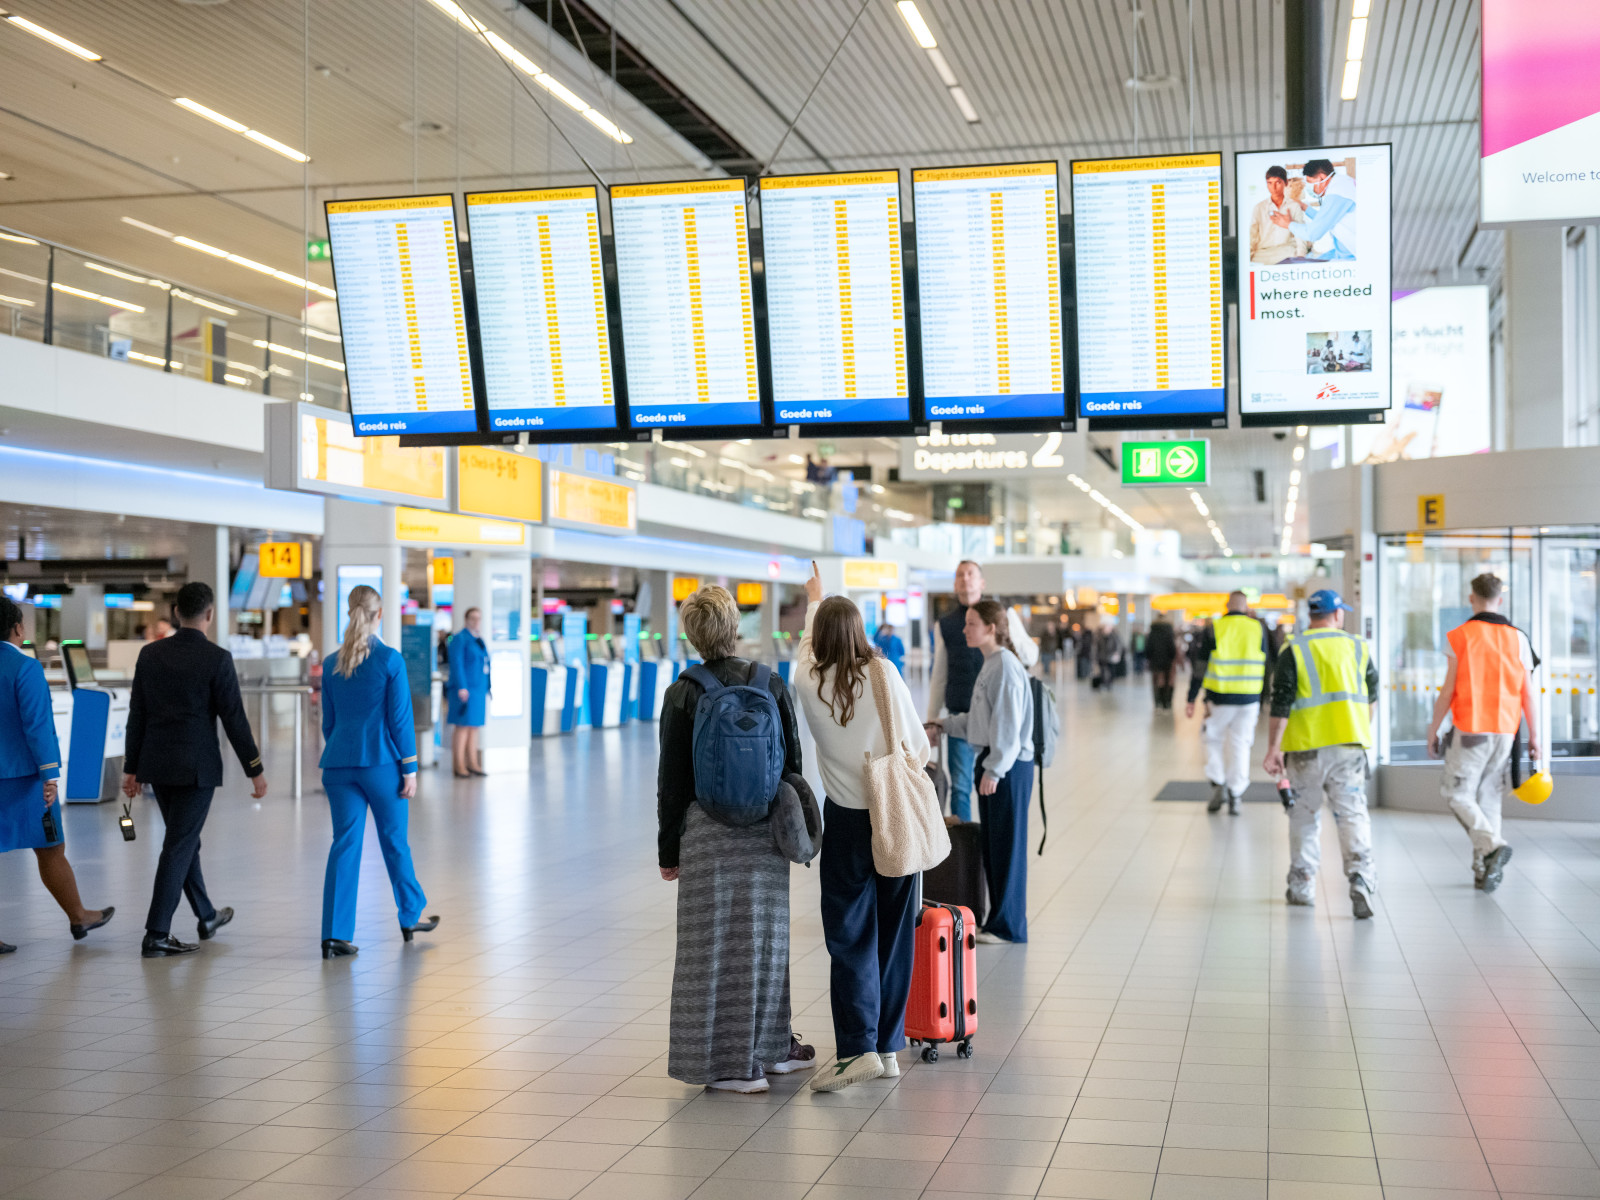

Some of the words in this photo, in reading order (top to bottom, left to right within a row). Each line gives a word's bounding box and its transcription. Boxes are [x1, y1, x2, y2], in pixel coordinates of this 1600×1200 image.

[1086, 163, 1109, 173] Flight
[1111, 161, 1154, 171] departures
[1161, 159, 1205, 167] Vertrekken
[927, 171, 949, 181] Flight
[950, 169, 992, 179] departures
[999, 167, 1042, 176] Vertrekken
[1523, 171, 1586, 184] Welcome
[773, 179, 794, 188] Flight
[795, 177, 836, 187] departures
[842, 175, 884, 184] Vertrekken
[623, 186, 643, 196] Flight
[645, 185, 685, 195] departures
[690, 183, 730, 192] Vertrekken
[479, 194, 499, 204] Flight
[500, 193, 538, 203] departures
[338, 202, 358, 212] Flight
[360, 201, 396, 211] departures
[1260, 267, 1356, 282] Destination:
[1260, 288, 1308, 300] where
[1313, 284, 1372, 298] needed
[1261, 307, 1304, 319] most.
[930, 405, 964, 415] Goede
[966, 404, 985, 414] reis
[1086, 401, 1121, 411] Goede
[1122, 400, 1142, 410] reis
[635, 413, 666, 422] Goede
[668, 412, 686, 422] reis
[780, 409, 812, 419] Goede
[814, 408, 832, 418] reis
[359, 422, 388, 431] Goede
[390, 421, 407, 430] reis
[494, 417, 525, 427] Goede
[527, 415, 544, 425] reis
[915, 449, 1028, 474] Departures
[1425, 499, 1437, 524] E
[268, 546, 292, 565] 14
